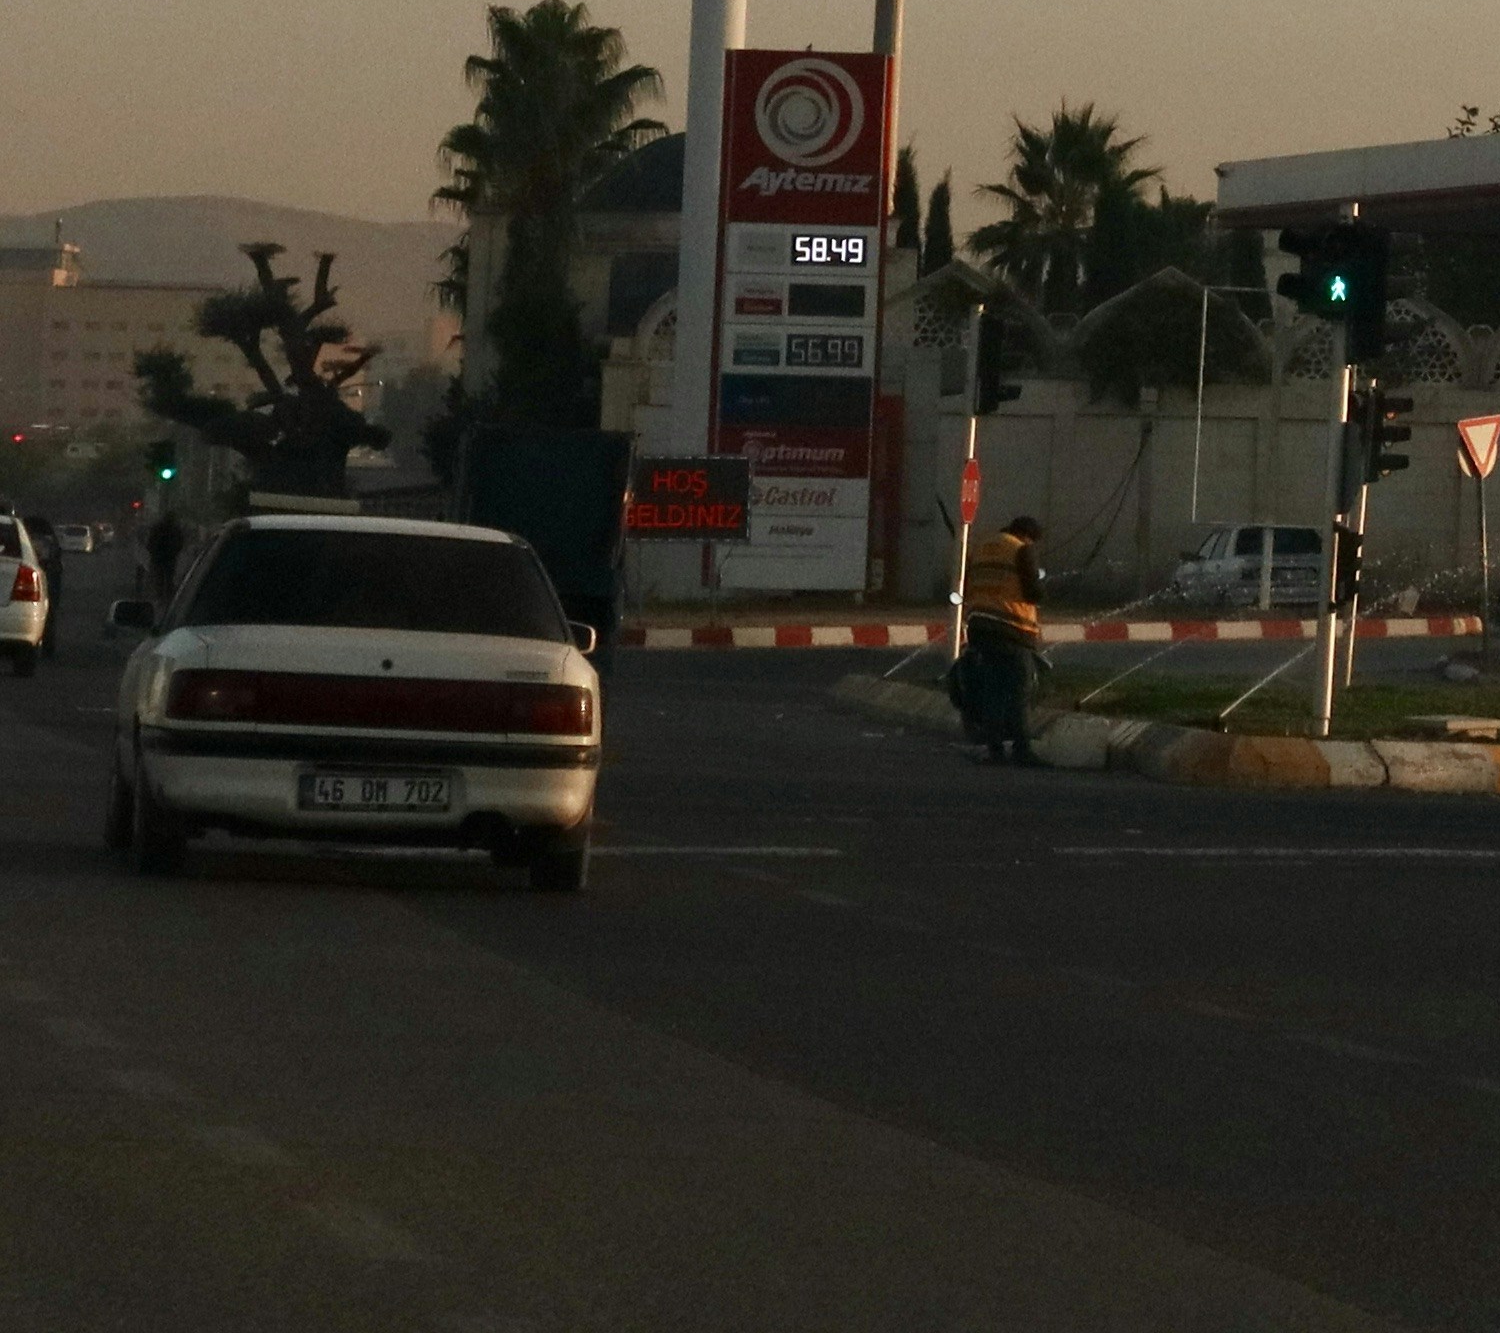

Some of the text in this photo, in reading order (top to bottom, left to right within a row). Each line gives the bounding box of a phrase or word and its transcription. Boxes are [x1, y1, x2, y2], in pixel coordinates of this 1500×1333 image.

[737, 166, 874, 196] Aytemiz
[794, 236, 864, 264] 58.49
[652, 469, 708, 498] HOŞ
[765, 487, 837, 506] Castrol
[318, 779, 344, 802] 46
[404, 780, 444, 803] 702
